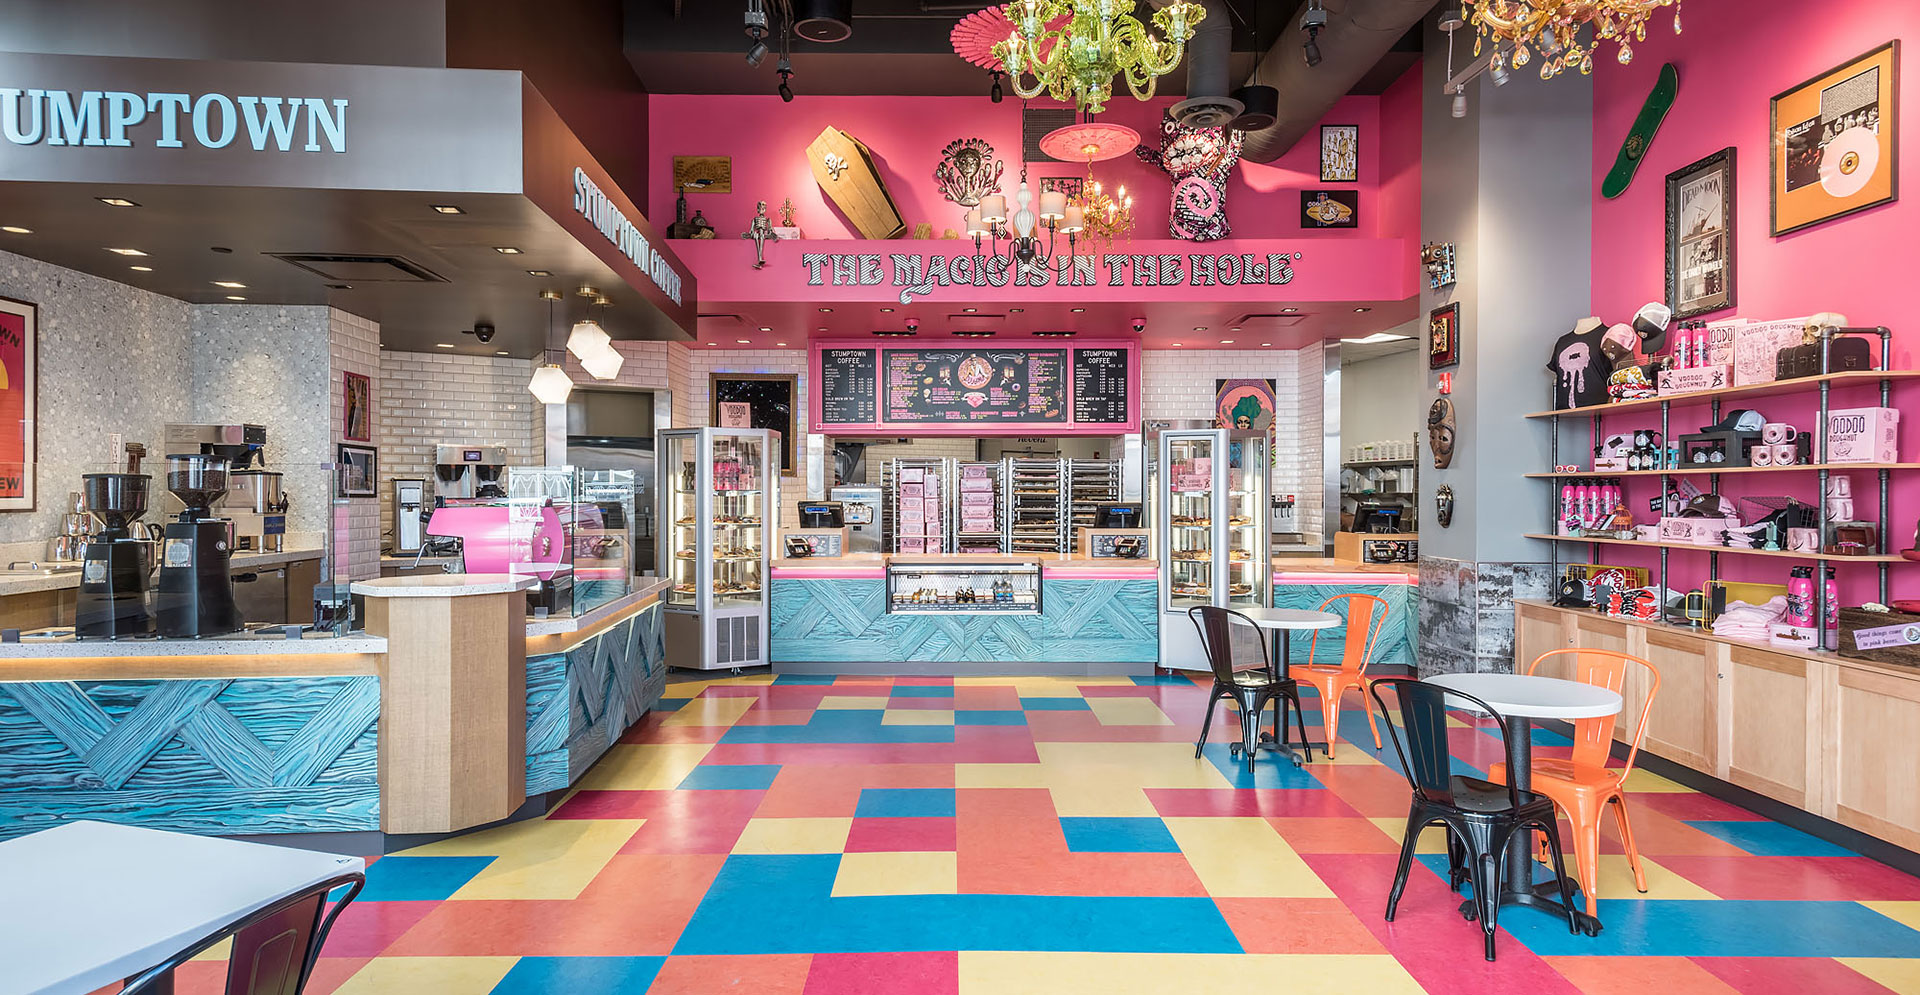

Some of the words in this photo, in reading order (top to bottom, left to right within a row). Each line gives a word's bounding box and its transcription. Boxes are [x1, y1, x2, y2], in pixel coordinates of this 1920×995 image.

[1682, 183, 1700, 212] DEAD
[1699, 176, 1721, 196] MOON
[574, 166, 649, 276] STUMPTOWN
[651, 248, 682, 307] COFFEE
[802, 253, 884, 287] THE
[889, 253, 1010, 305] MAGIC
[1013, 254, 1051, 287] IS
[1056, 254, 1097, 287] IN
[1103, 254, 1185, 287] THE
[1741, 325, 1768, 337] VOODOO
[1678, 374, 1704, 382] VOODOO
[1675, 381, 1707, 389] DOUGHNUT
[1829, 434, 1857, 442] DOUGHNUT
[1870, 639, 1881, 648] pink
